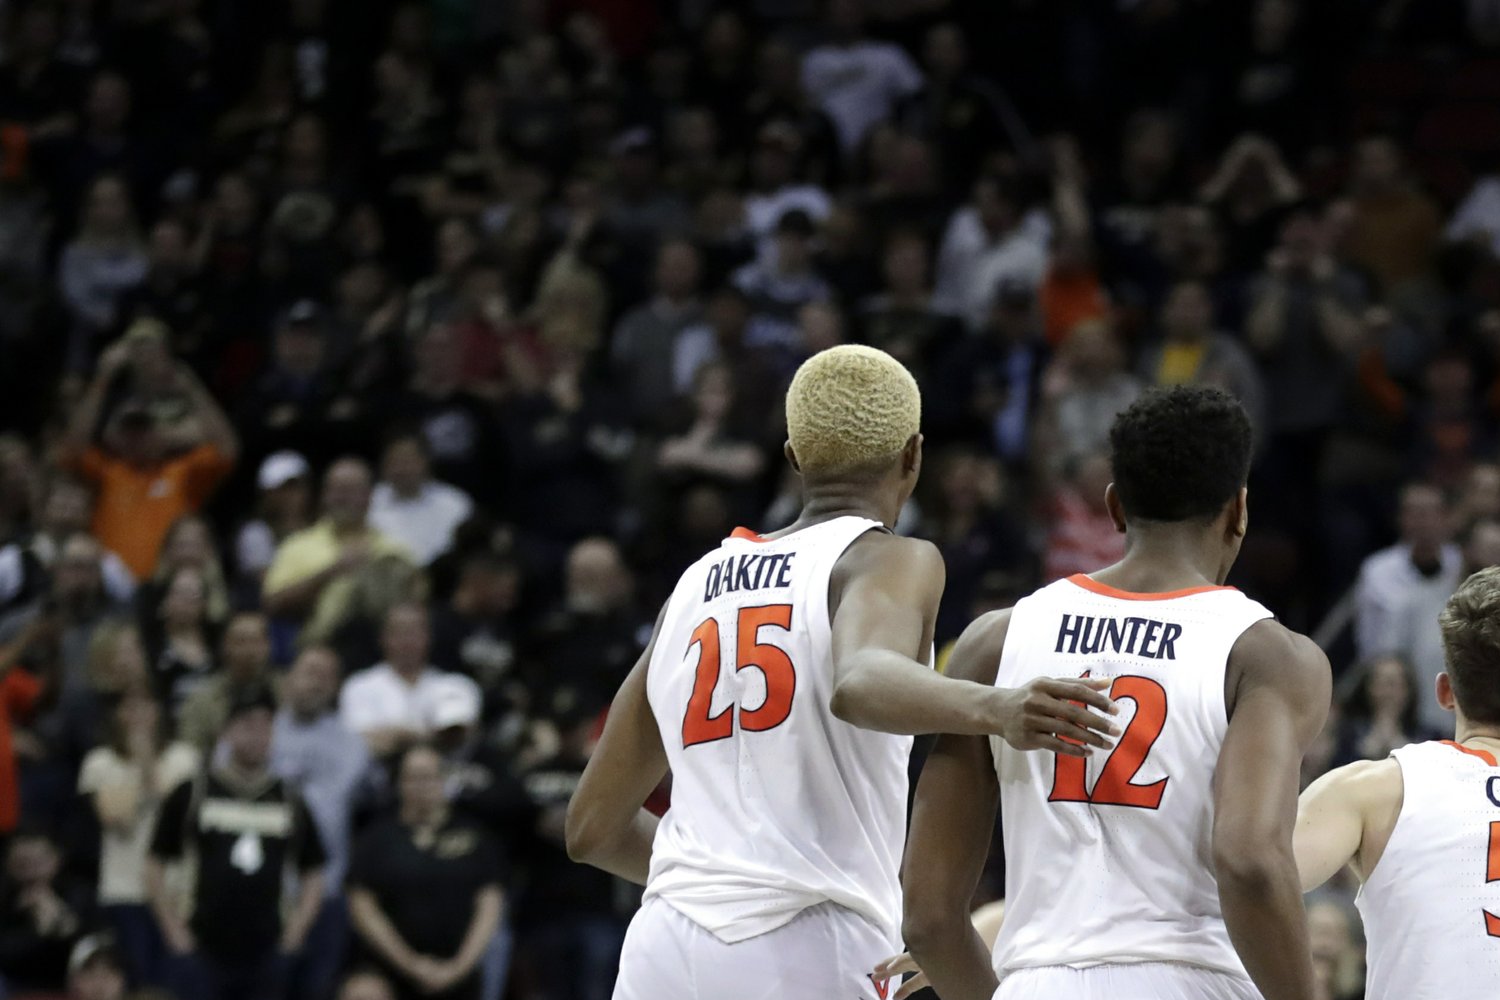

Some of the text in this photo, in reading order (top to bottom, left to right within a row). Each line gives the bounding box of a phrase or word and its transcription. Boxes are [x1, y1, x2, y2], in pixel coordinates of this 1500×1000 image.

[704, 551, 797, 602] DIAKITE
[1054, 613, 1182, 661] HUNTER
[682, 603, 797, 750] 25
